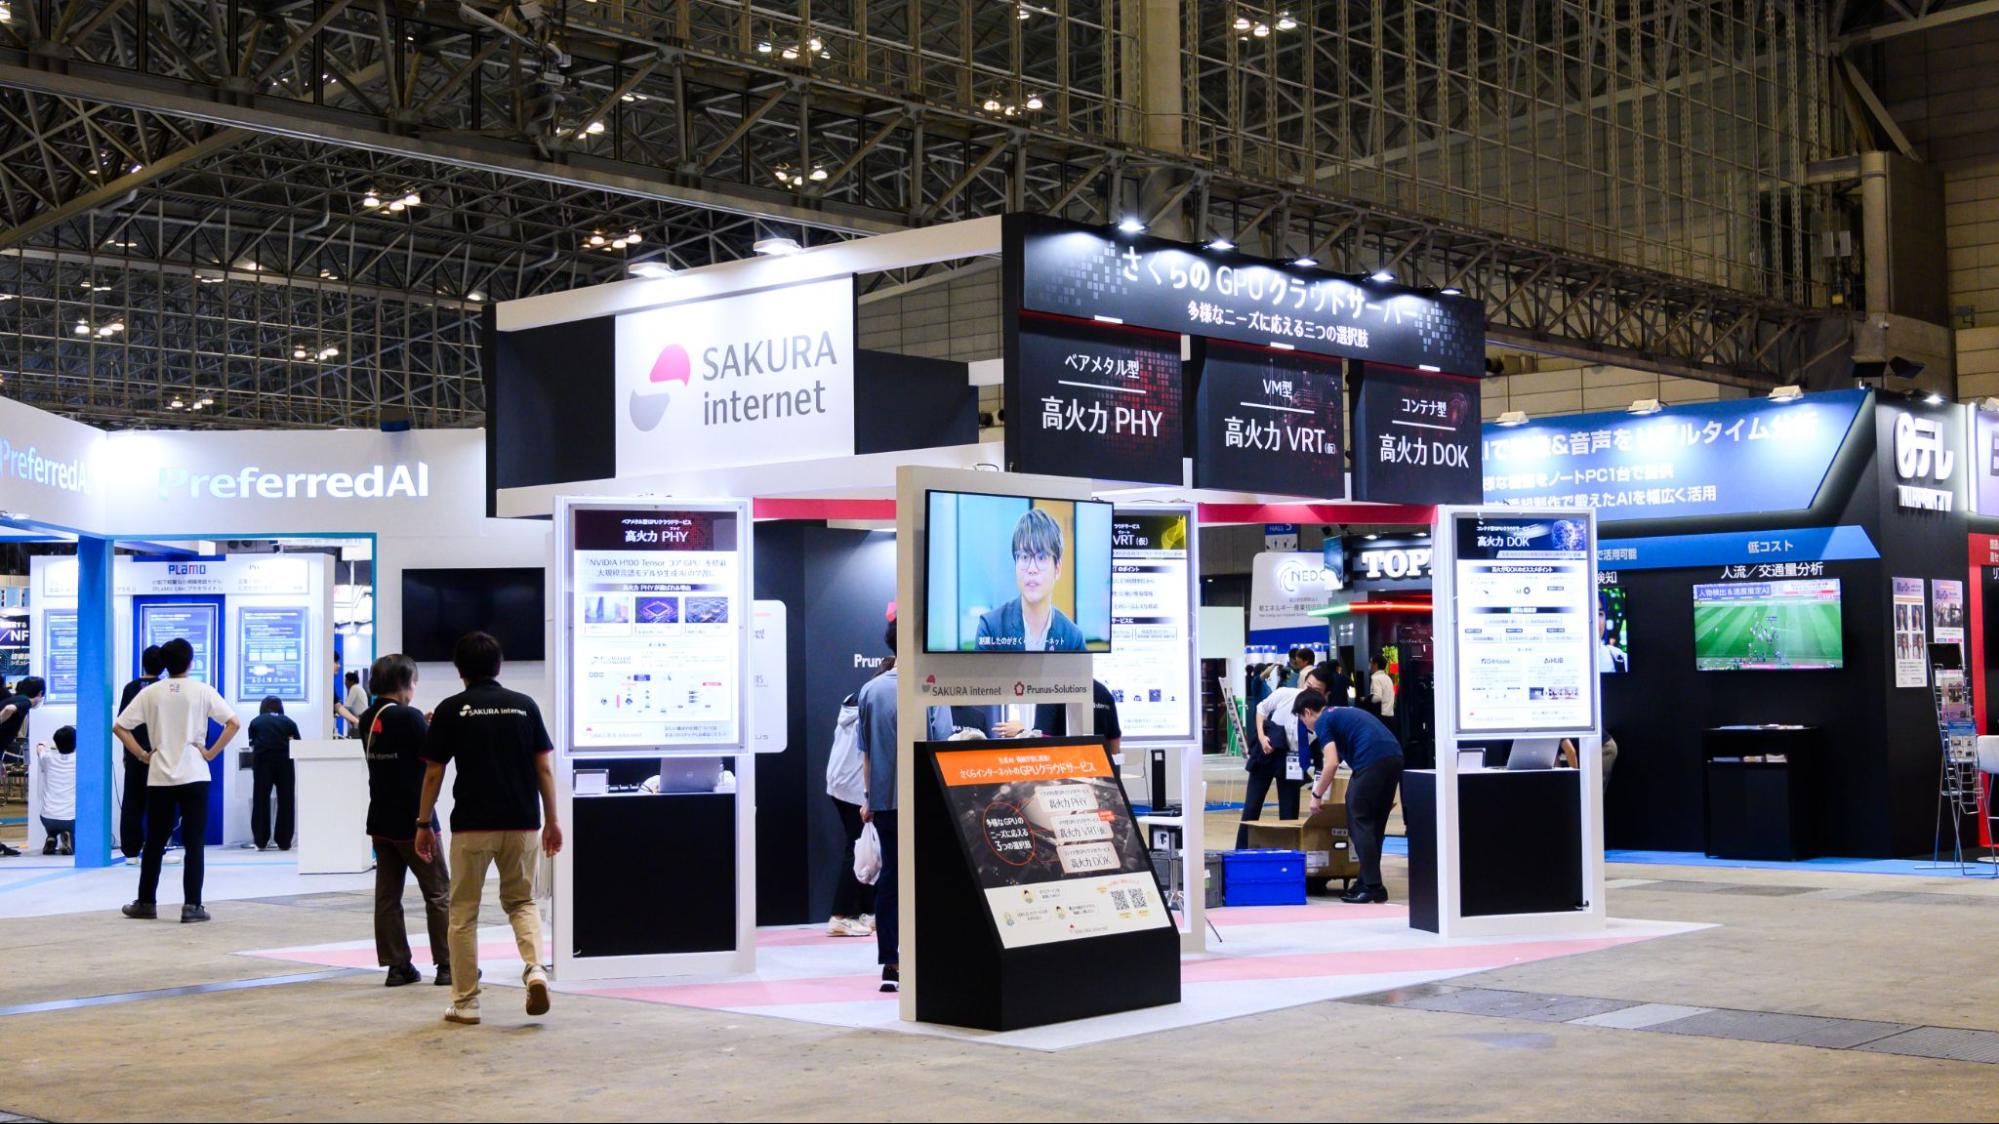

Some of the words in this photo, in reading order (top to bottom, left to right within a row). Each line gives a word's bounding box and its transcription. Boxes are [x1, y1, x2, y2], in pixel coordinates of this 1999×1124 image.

[1122, 246, 1210, 291] さくらの
[1216, 265, 1264, 301] GPU
[1188, 300, 1369, 349] 多様なニーズに応える三つの選択肢
[702, 330, 838, 382] SAKURA
[1064, 353, 1140, 380] ベアメタル型
[1262, 379, 1293, 399] VM型
[703, 379, 826, 427] internet
[1401, 398, 1447, 418] コンテナ型
[1041, 396, 1108, 435] 高火力
[1115, 406, 1162, 438] PHY
[1224, 416, 1281, 451] 高火力
[1379, 433, 1428, 465] 高火力
[1433, 442, 1469, 469] DOK
[158, 461, 429, 501] PreferredAI
[625, 530, 658, 543] 高火力
[661, 530, 689, 543] PHY
[1477, 535, 1503, 547] 高火力
[1507, 535, 1530, 547] DOK
[1748, 541, 1794, 554] 低コスト
[1361, 549, 1432, 579] TOP
[1721, 561, 1824, 579] 人流／交通量分析
[932, 686, 968, 697] SAKURA
[970, 685, 1002, 696] internet
[1027, 684, 1087, 695] Prunus-Solutions
[468, 706, 499, 716] SAKURA
